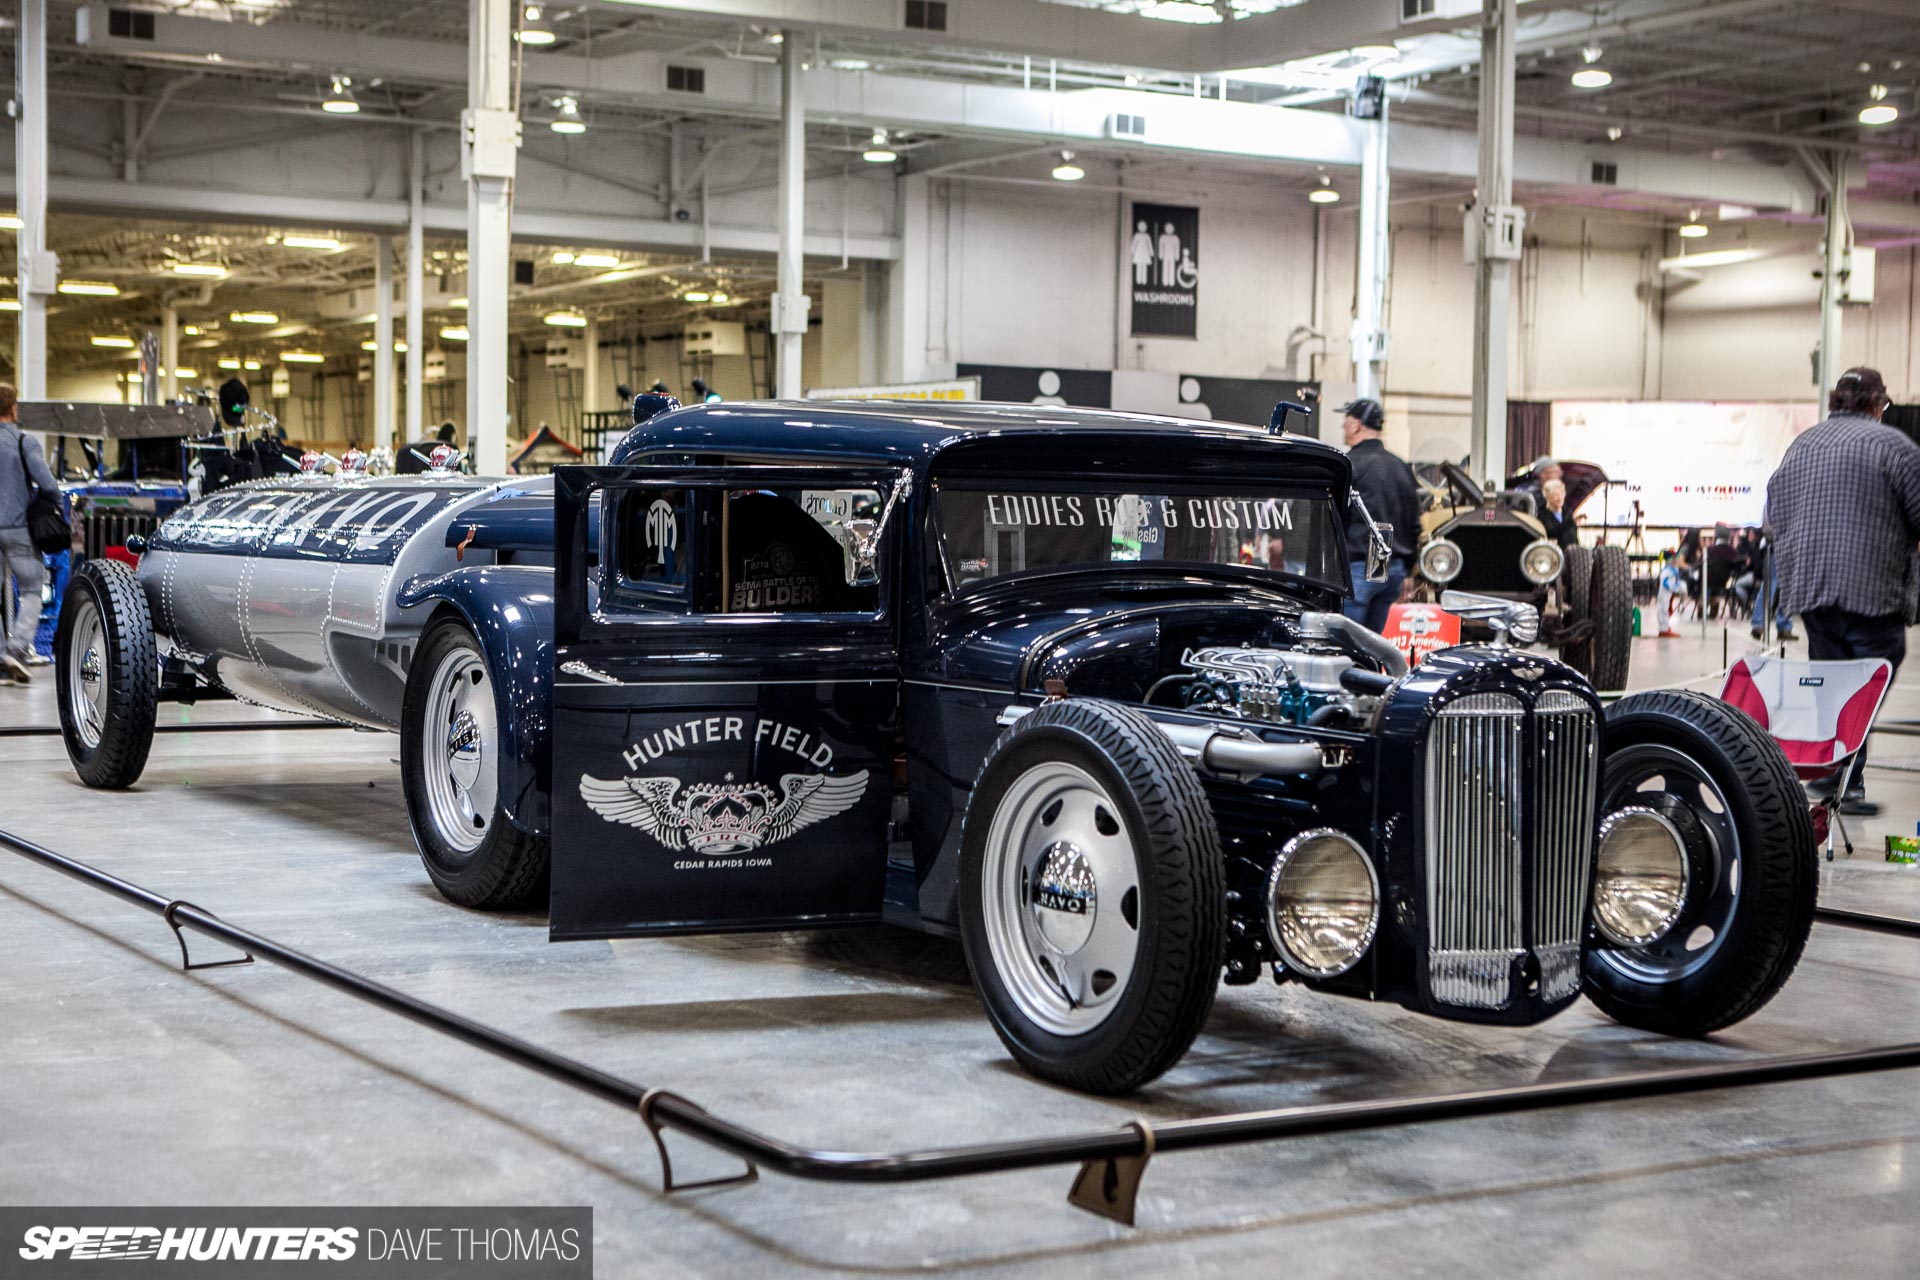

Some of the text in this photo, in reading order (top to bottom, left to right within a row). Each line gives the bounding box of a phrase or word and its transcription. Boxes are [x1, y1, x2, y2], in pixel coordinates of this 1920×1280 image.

[1134, 291, 1195, 306] WASHROOMS
[987, 494, 1085, 527] EDDIES
[1160, 498, 1178, 528] &
[1188, 498, 1293, 531] CUSTOM
[734, 579, 762, 592] SEMA
[763, 577, 795, 588] BATTLE
[1409, 635, 1450, 649] American
[622, 716, 833, 772] HUNTER FIELD
[674, 858, 773, 870] CEDAR RAPIDS IOWA
